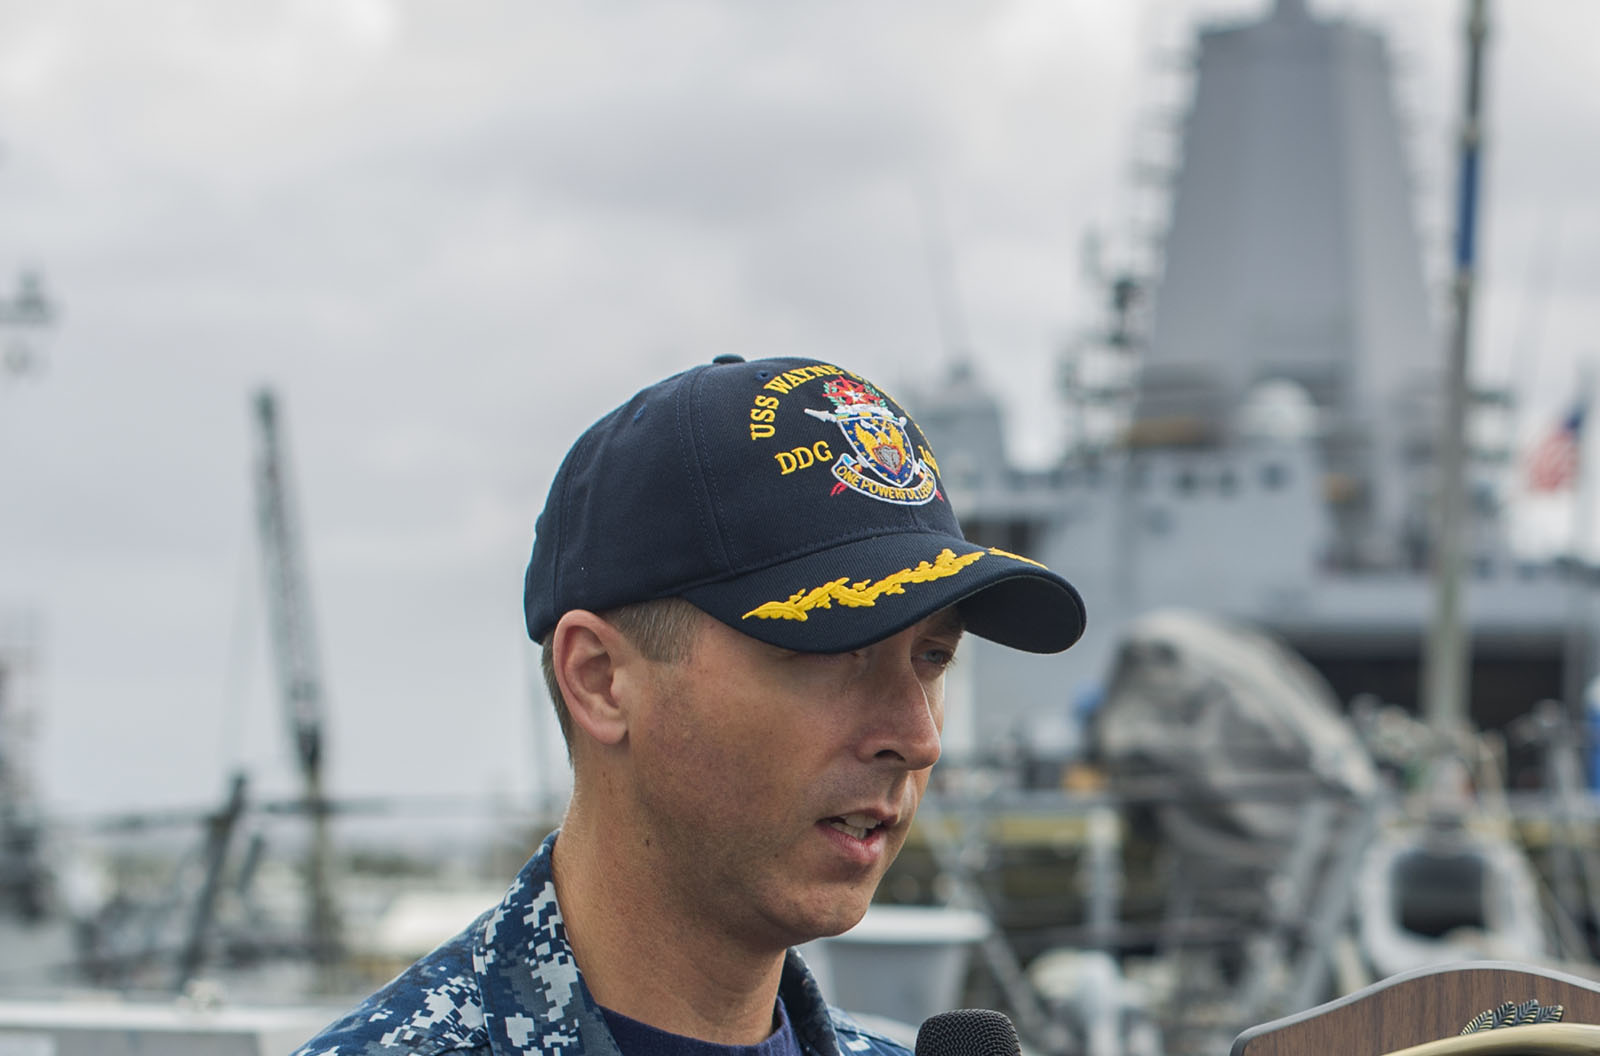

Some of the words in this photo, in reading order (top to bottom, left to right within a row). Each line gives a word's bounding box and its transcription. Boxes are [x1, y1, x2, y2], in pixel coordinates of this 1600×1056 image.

[763, 365, 844, 394] WAYNE
[750, 395, 780, 440] USS
[774, 440, 833, 475] DDG
[836, 465, 862, 488] ONE
[861, 480, 919, 500] POWERFUL
